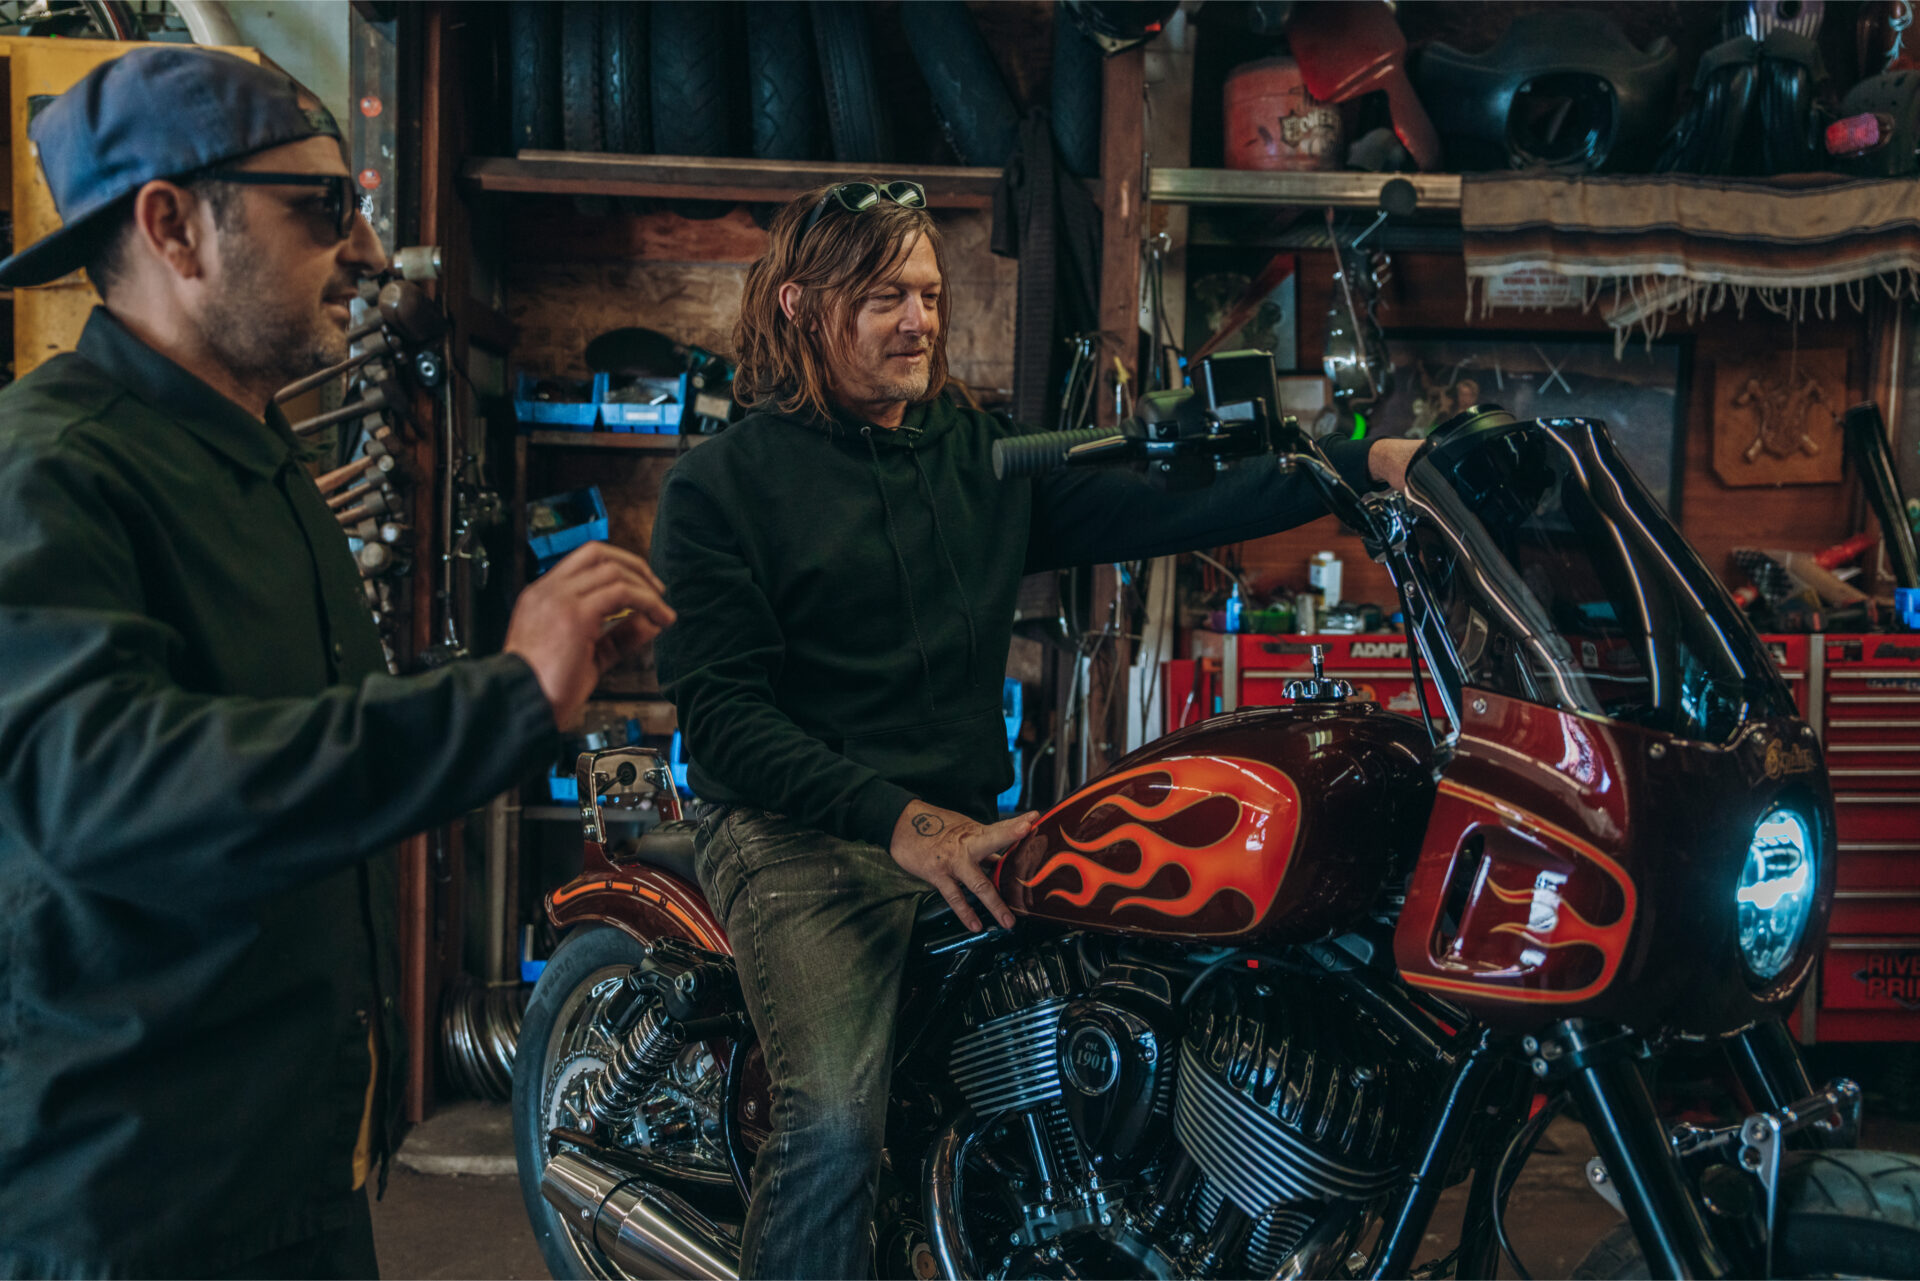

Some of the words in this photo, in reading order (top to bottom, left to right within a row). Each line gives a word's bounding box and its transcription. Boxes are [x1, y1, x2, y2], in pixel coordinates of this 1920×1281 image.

[1350, 641, 1421, 659] ADAPT
[1866, 977, 1920, 999] PRI
[1075, 1050, 1108, 1072] 1901
